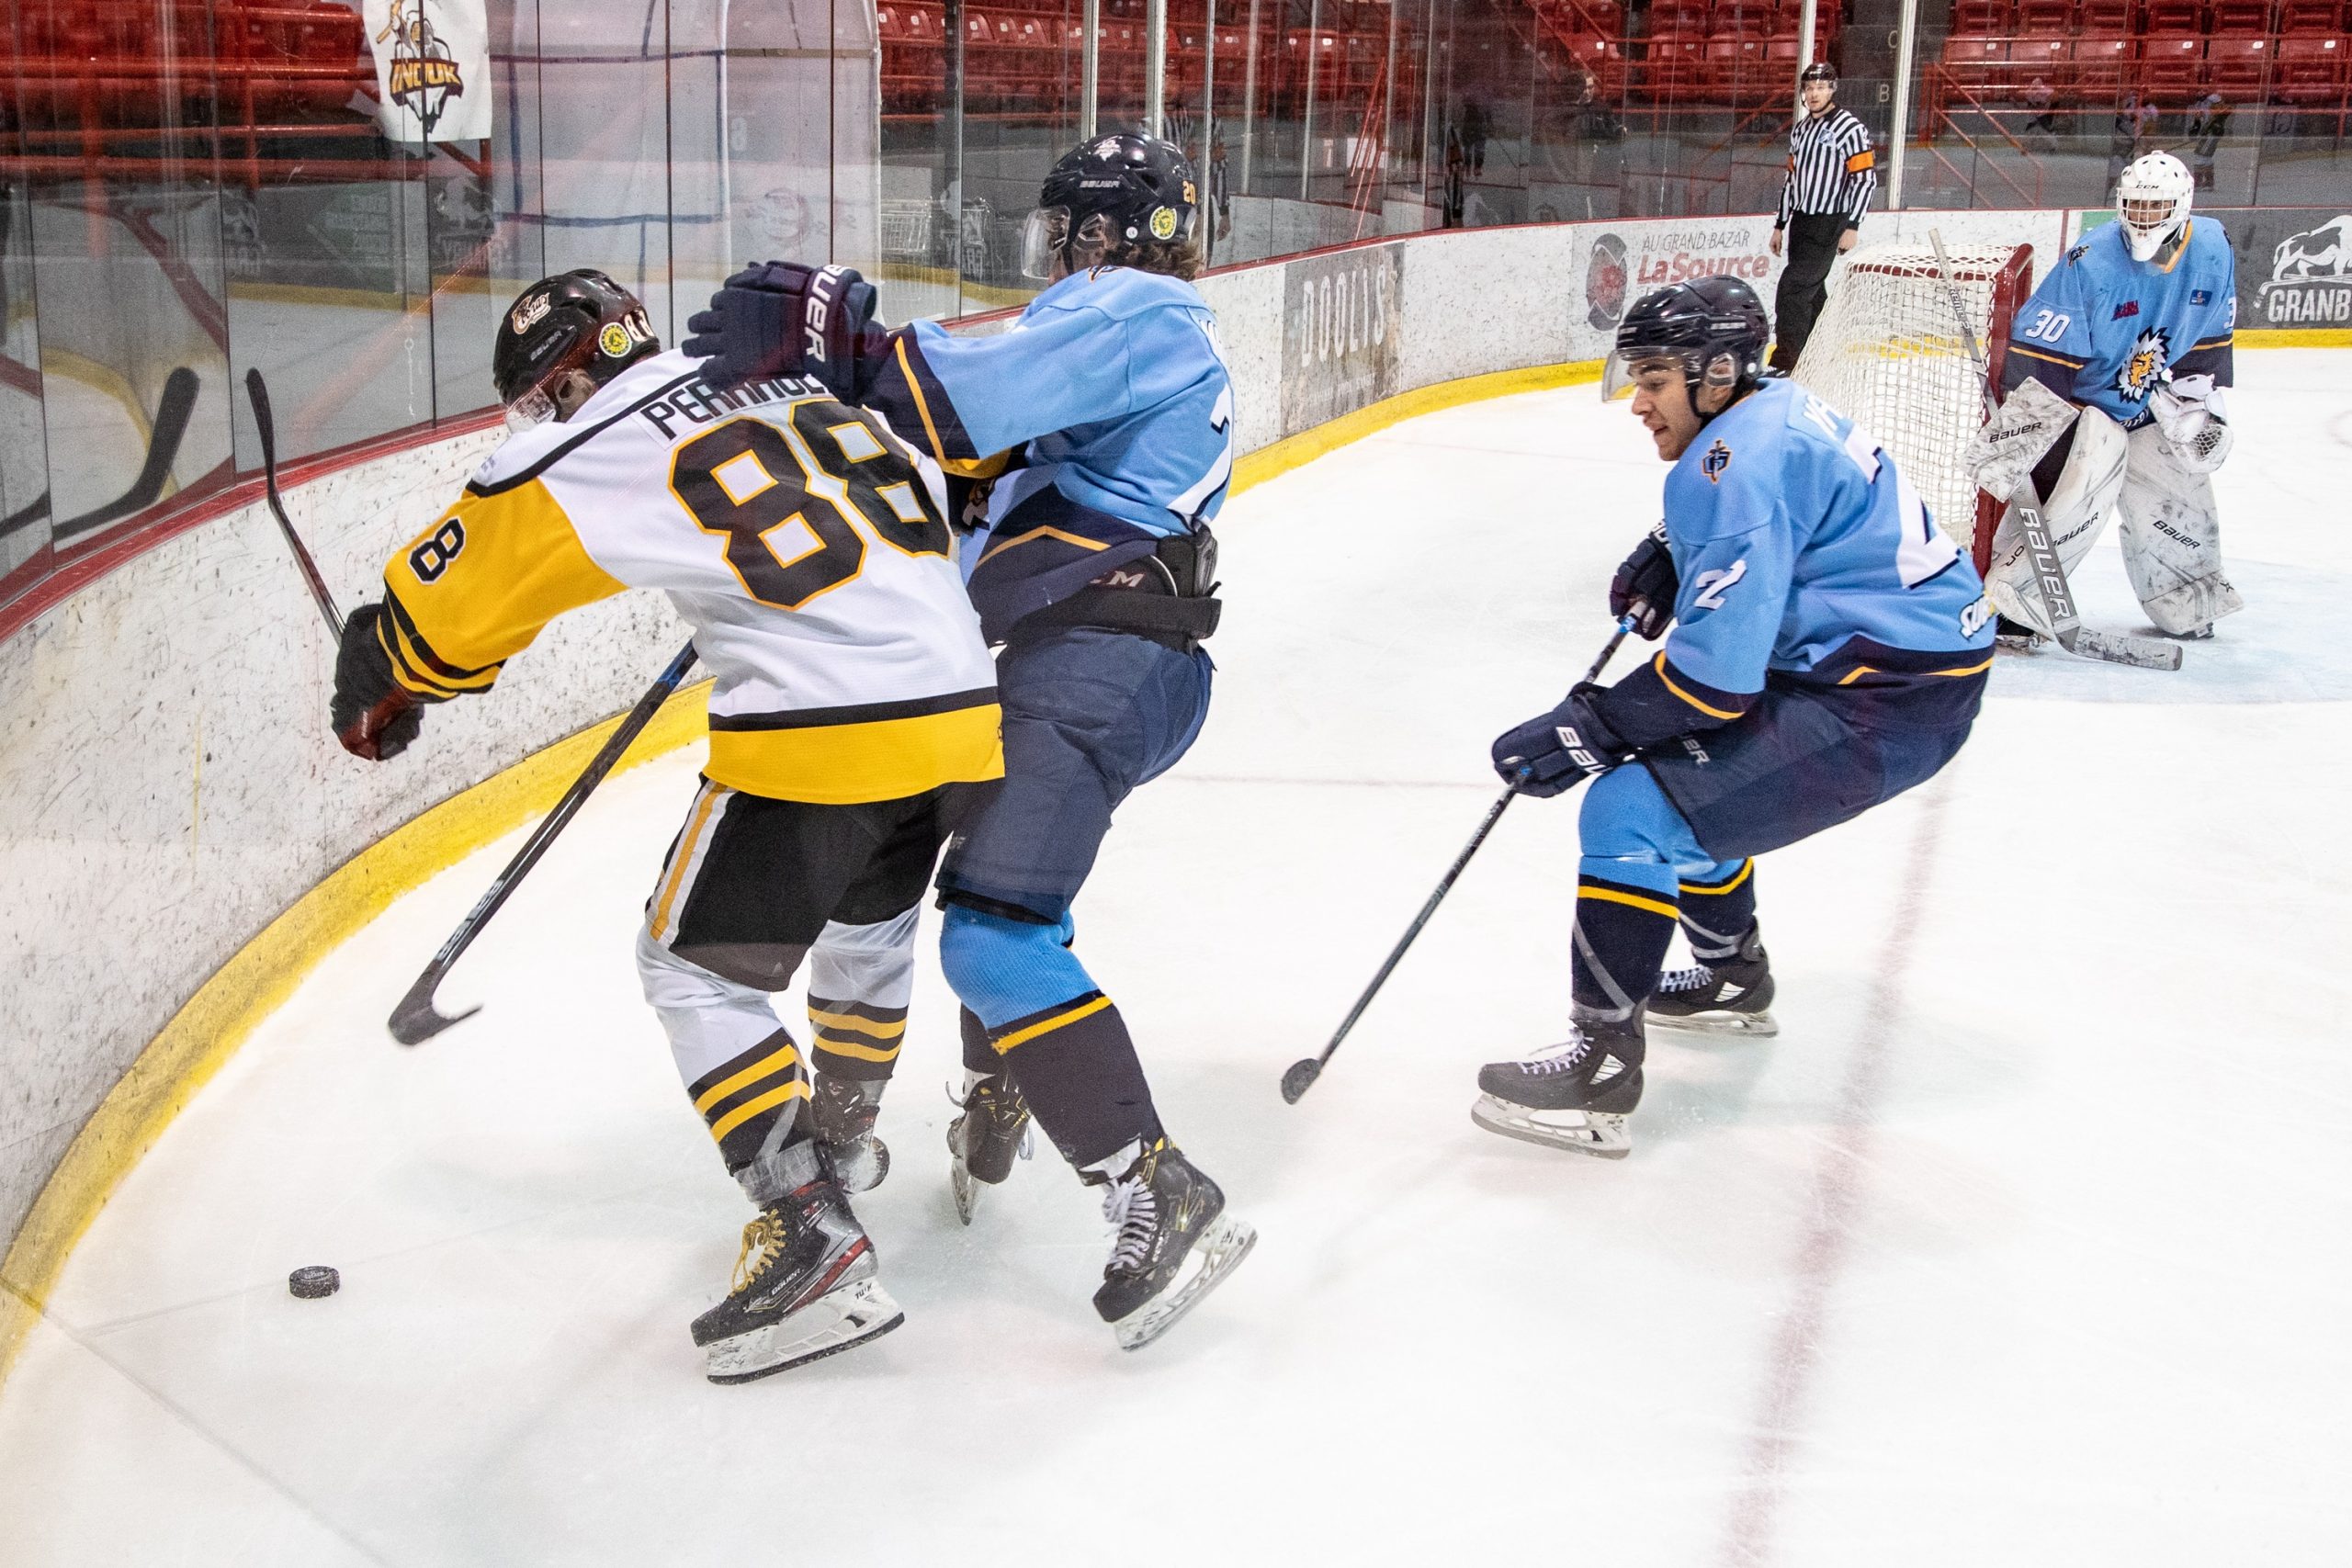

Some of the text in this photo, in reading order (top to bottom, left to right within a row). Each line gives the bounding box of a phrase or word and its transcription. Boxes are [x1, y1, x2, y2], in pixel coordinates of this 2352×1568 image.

[391, 62, 461, 94] INOUK
[1880, 85, 1890, 102] B
[1182, 180, 1196, 205] 20
[1642, 231, 1751, 253] AU GRAND BAZAR
[2267, 288, 2352, 322] GRANB
[2026, 309, 2071, 344] 30
[1988, 422, 2042, 444] BAUER
[668, 398, 951, 612] 88
[407, 515, 467, 586] 8
[2153, 519, 2201, 550] BAUER
[2018, 507, 2071, 619] BAUER
[1694, 558, 1747, 611] 2
[771, 1268, 802, 1296] BAUER
